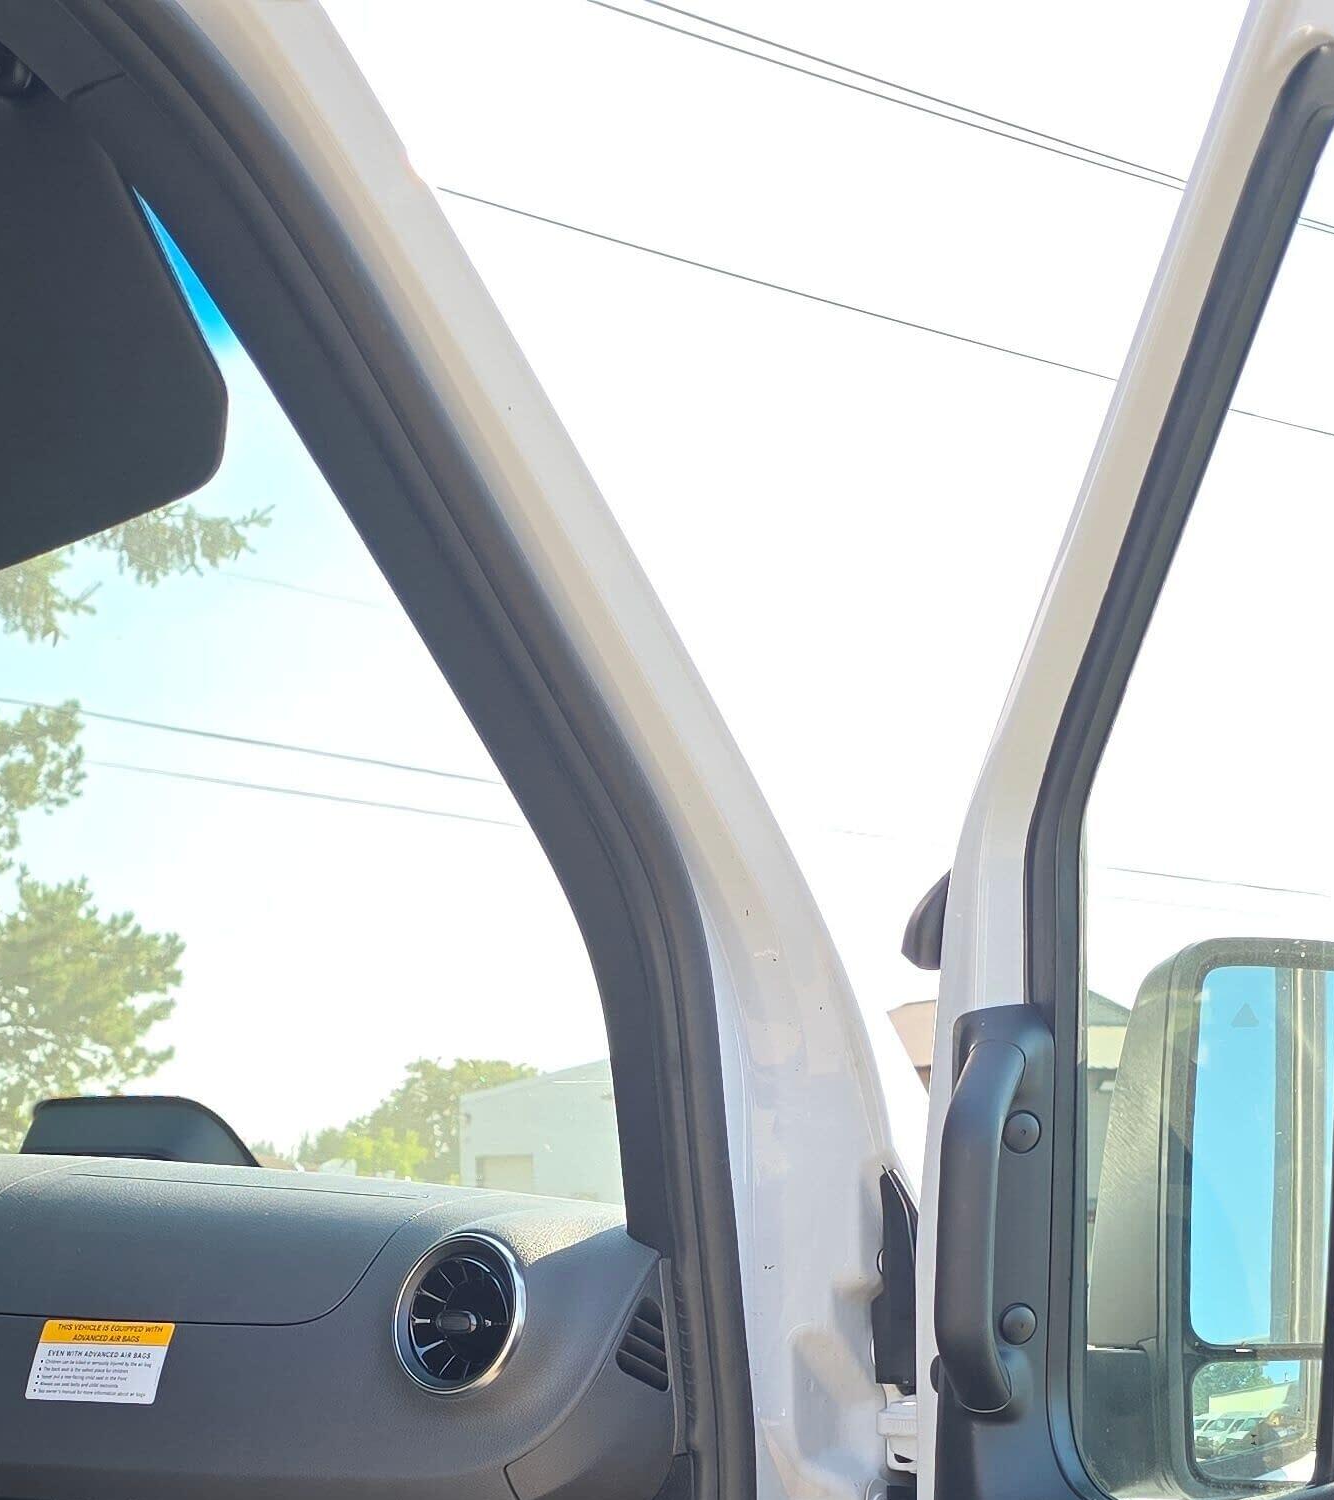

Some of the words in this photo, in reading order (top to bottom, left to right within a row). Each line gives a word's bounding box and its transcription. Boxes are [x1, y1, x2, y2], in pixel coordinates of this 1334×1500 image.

[74, 1324, 102, 1332] VEHICLE
[110, 1325, 144, 1333] EQUIPPED
[72, 1334, 109, 1342] ADVANCED
[84, 1350, 119, 1358] ADVANCED
